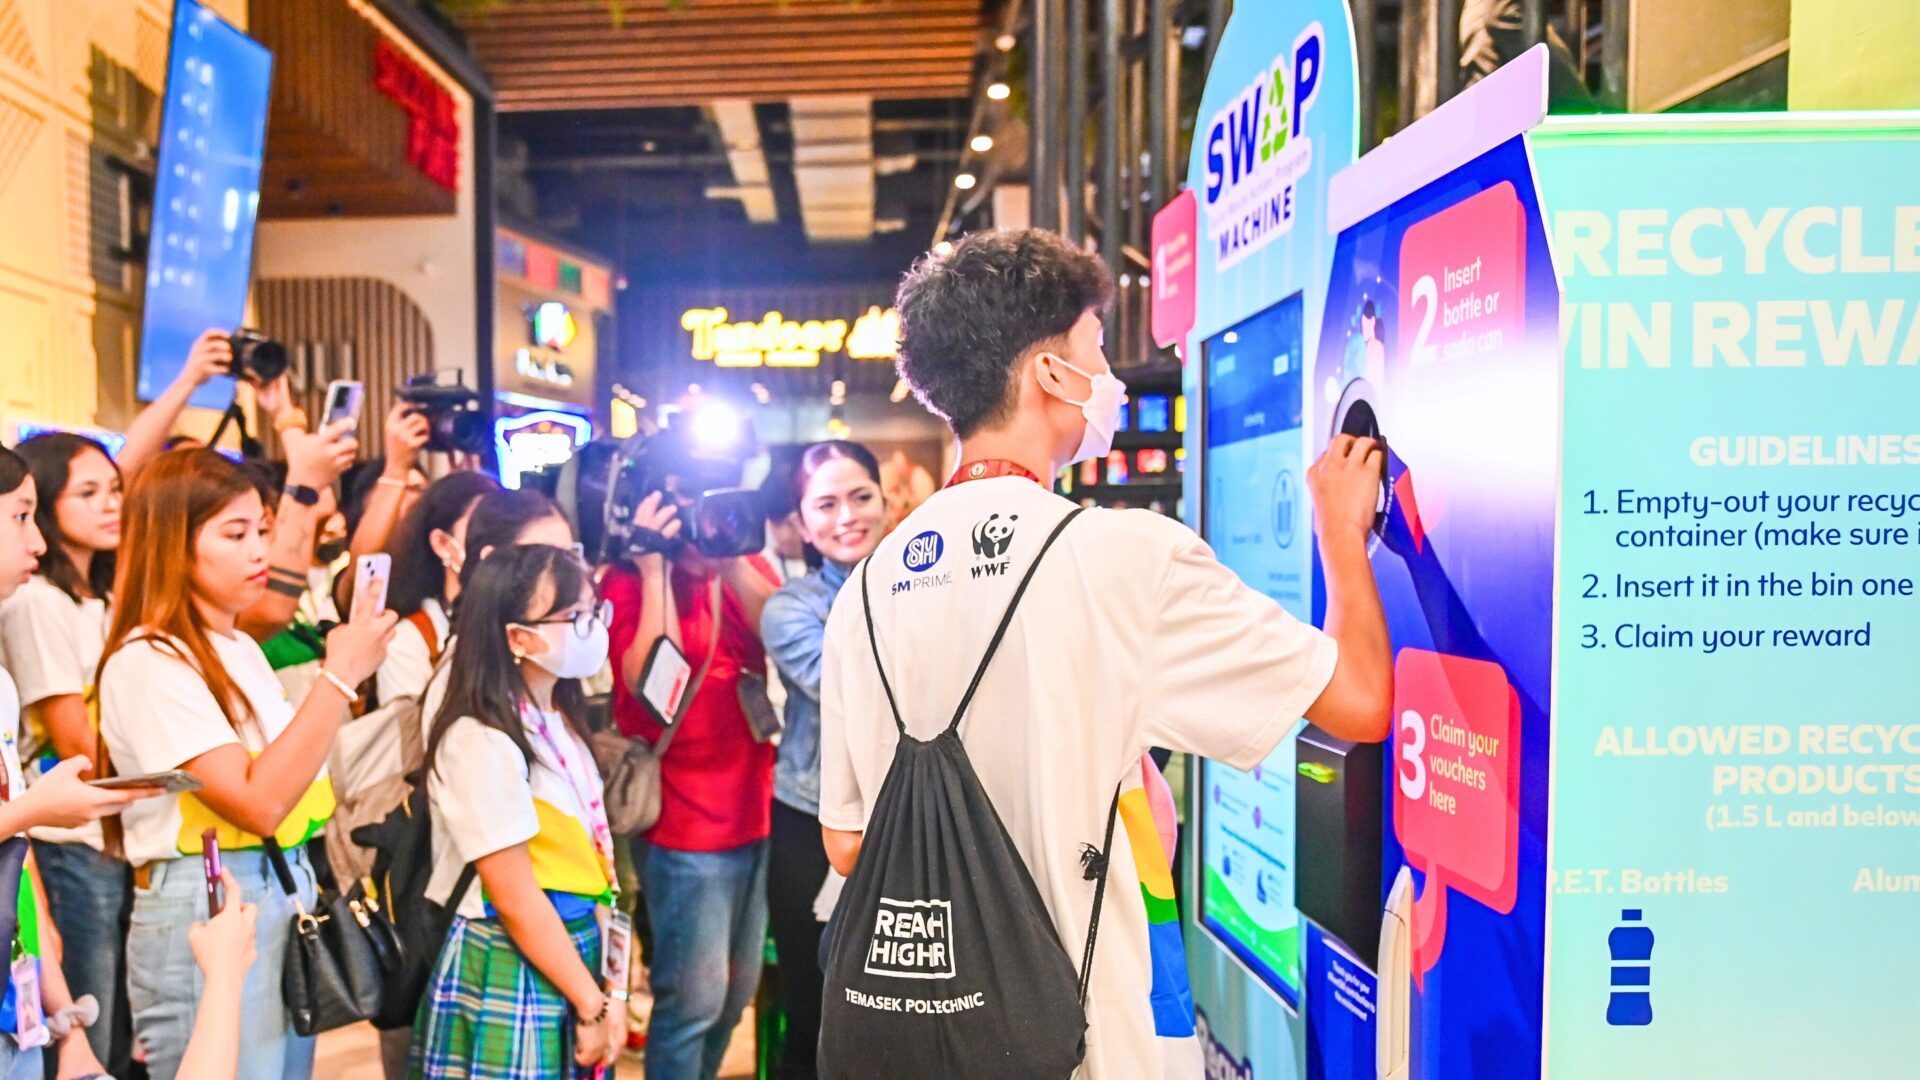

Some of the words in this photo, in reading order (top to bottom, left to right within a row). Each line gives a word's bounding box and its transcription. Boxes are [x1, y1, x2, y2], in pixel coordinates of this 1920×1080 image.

[1219, 184, 1292, 261] MACHINE
[1444, 256, 1482, 293] Insert
[1411, 274, 1438, 367] 2
[1443, 292, 1482, 328] bottle
[1484, 291, 1500, 315] or
[1562, 303, 1672, 369] IN
[1689, 434, 1920, 467] GUIDELINES
[1583, 489, 1609, 515] 1.
[1617, 489, 1770, 520] Empty-out
[1777, 494, 1841, 519] your
[1615, 523, 1748, 548] container
[1754, 520, 1841, 551] (make
[1849, 527, 1909, 546] sure
[892, 580, 911, 596] SM
[913, 571, 953, 590] PRIME
[971, 562, 1011, 580] WWF
[1581, 573, 1608, 599] 2.
[1616, 573, 1695, 598] Insert
[1702, 573, 1720, 597] it
[1727, 573, 1750, 597] in
[1757, 572, 1803, 597] the
[1811, 571, 1853, 596] bin
[1861, 578, 1914, 596] one
[1581, 624, 1607, 649] 3.
[1614, 623, 1693, 649] Claim
[1702, 630, 1766, 654] your
[1772, 621, 1871, 647] reward
[1430, 713, 1466, 748] Claim
[1467, 731, 1500, 758] your
[1593, 725, 1792, 757] ALLOWED
[1400, 709, 1427, 800] 3
[1430, 755, 1487, 791] vouchers
[1712, 764, 1920, 796] PRODUCTS
[1429, 780, 1457, 816] here
[1705, 804, 1760, 832] (1.5
[1765, 804, 1783, 828] L
[1786, 805, 1838, 828] and
[1620, 868, 1729, 894] Bottles
[845, 987, 902, 1012] TEMASEK
